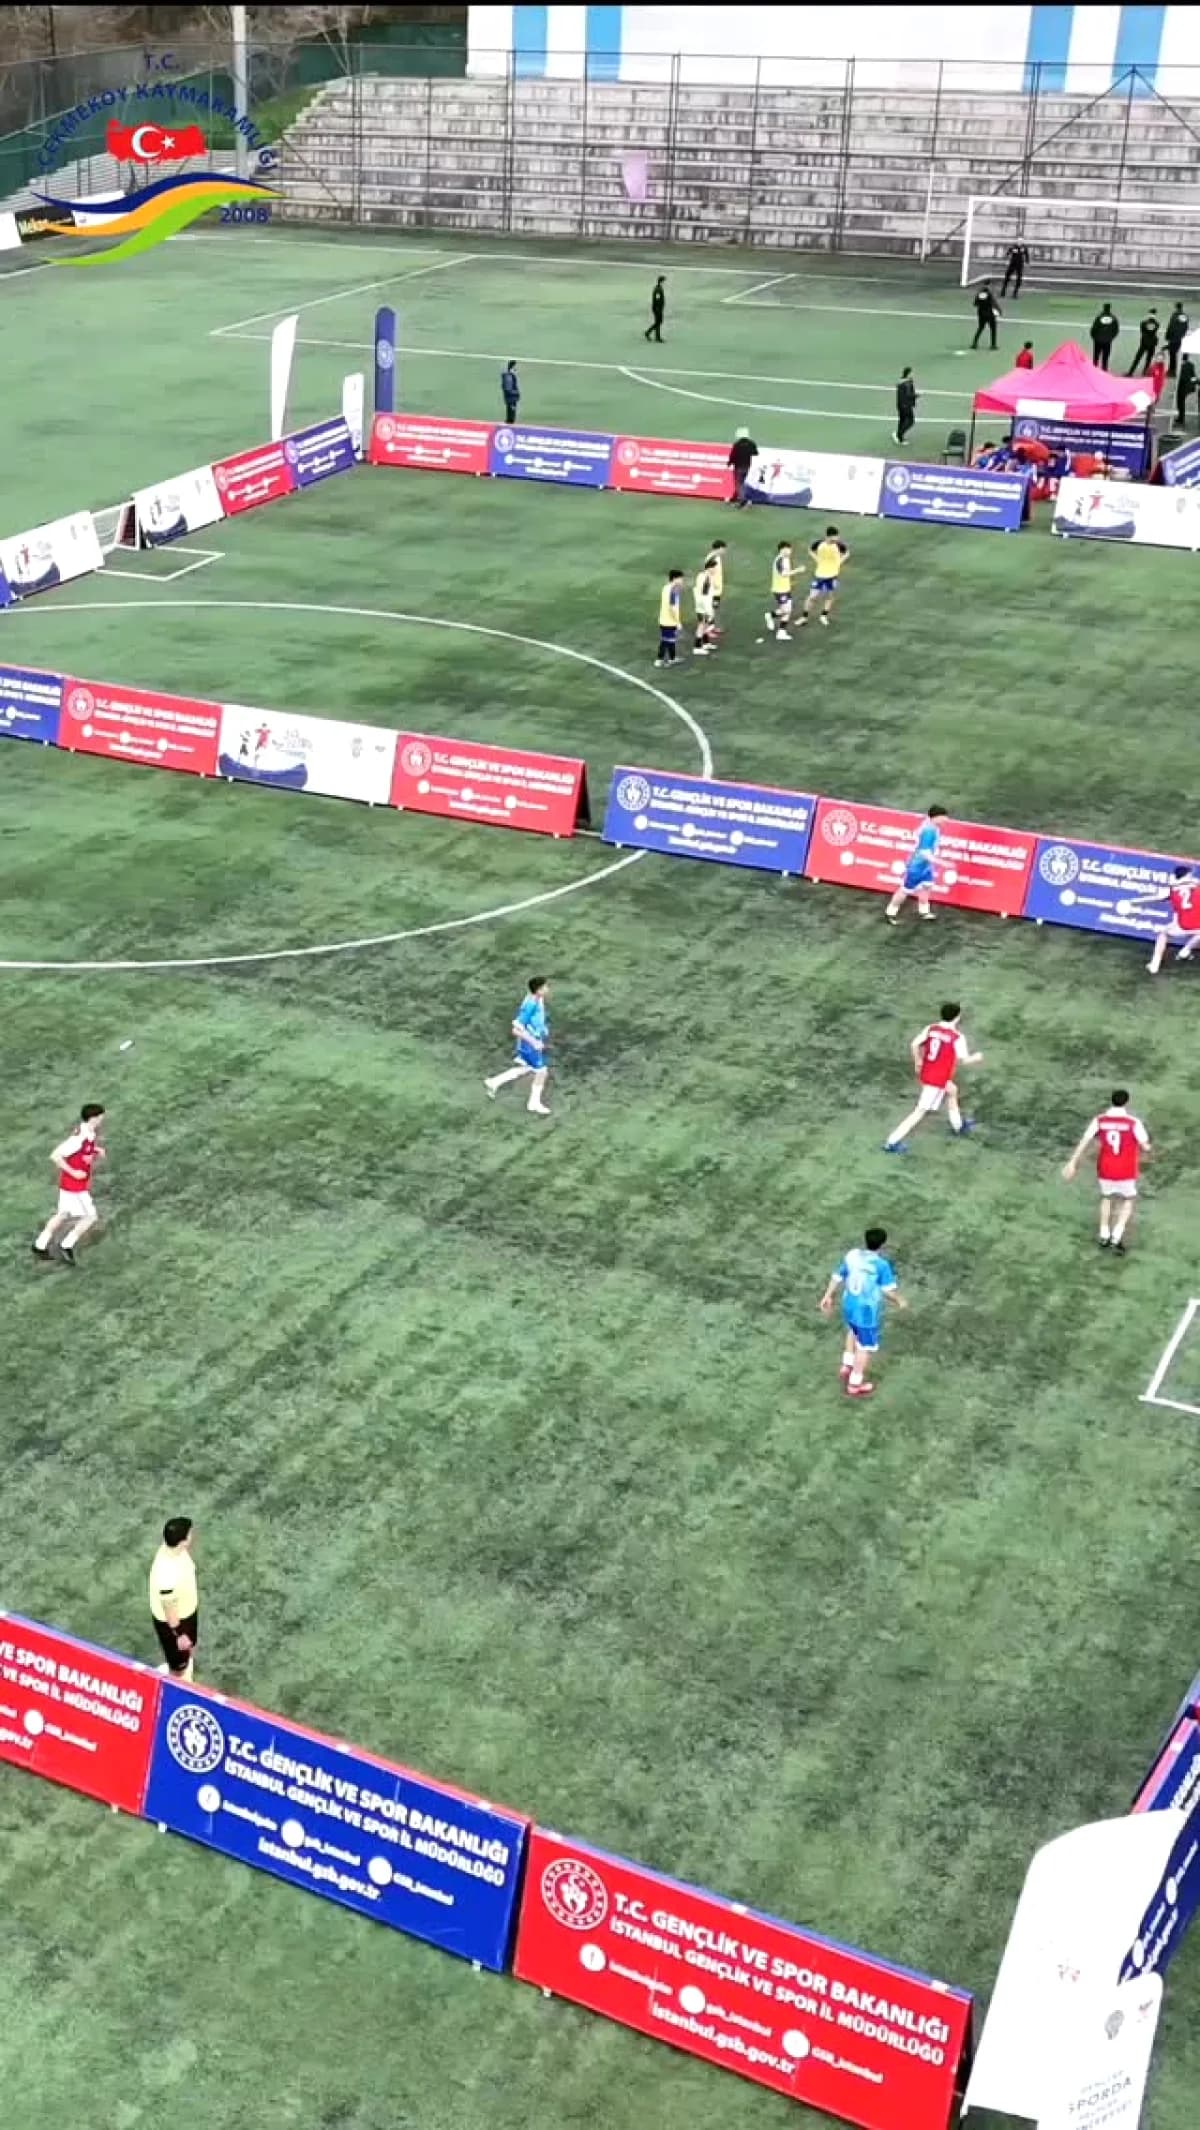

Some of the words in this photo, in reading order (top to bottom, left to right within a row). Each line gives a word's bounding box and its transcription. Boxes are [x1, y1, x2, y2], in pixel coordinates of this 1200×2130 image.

[1178, 886, 1193, 909] 2
[1106, 1130, 1121, 1155] 9
[16, 1648, 57, 1677] SPOR
[58, 1665, 143, 1713] BAKANLIĞI
[224, 1759, 286, 1797] İSTANBUL
[287, 1784, 342, 1820] GENÇLİK
[343, 1808, 361, 1828] VE
[362, 1817, 399, 1843] SPOR
[228, 1735, 257, 1762] T.C.
[260, 1747, 334, 1793] GENÇLİK
[335, 1777, 358, 1804] VE
[359, 1789, 407, 1822] SPOR
[409, 1811, 509, 1866] BAKANLIĞI
[609, 1917, 682, 1959] İSTANBUL
[685, 1947, 749, 1988] GENÇLİK
[751, 1975, 774, 1997] VE
[775, 1985, 818, 2014] SPOR
[820, 1998, 834, 2023] İL
[837, 2011, 944, 2066] MÜDÜRLÜĞÜ
[614, 1893, 648, 1923] T.C.
[651, 1910, 738, 1956] GENÇLİK
[740, 1944, 770, 1969] VE
[771, 1956, 827, 1995] SPOR
[829, 1979, 949, 2043] BAKANLIĞI
